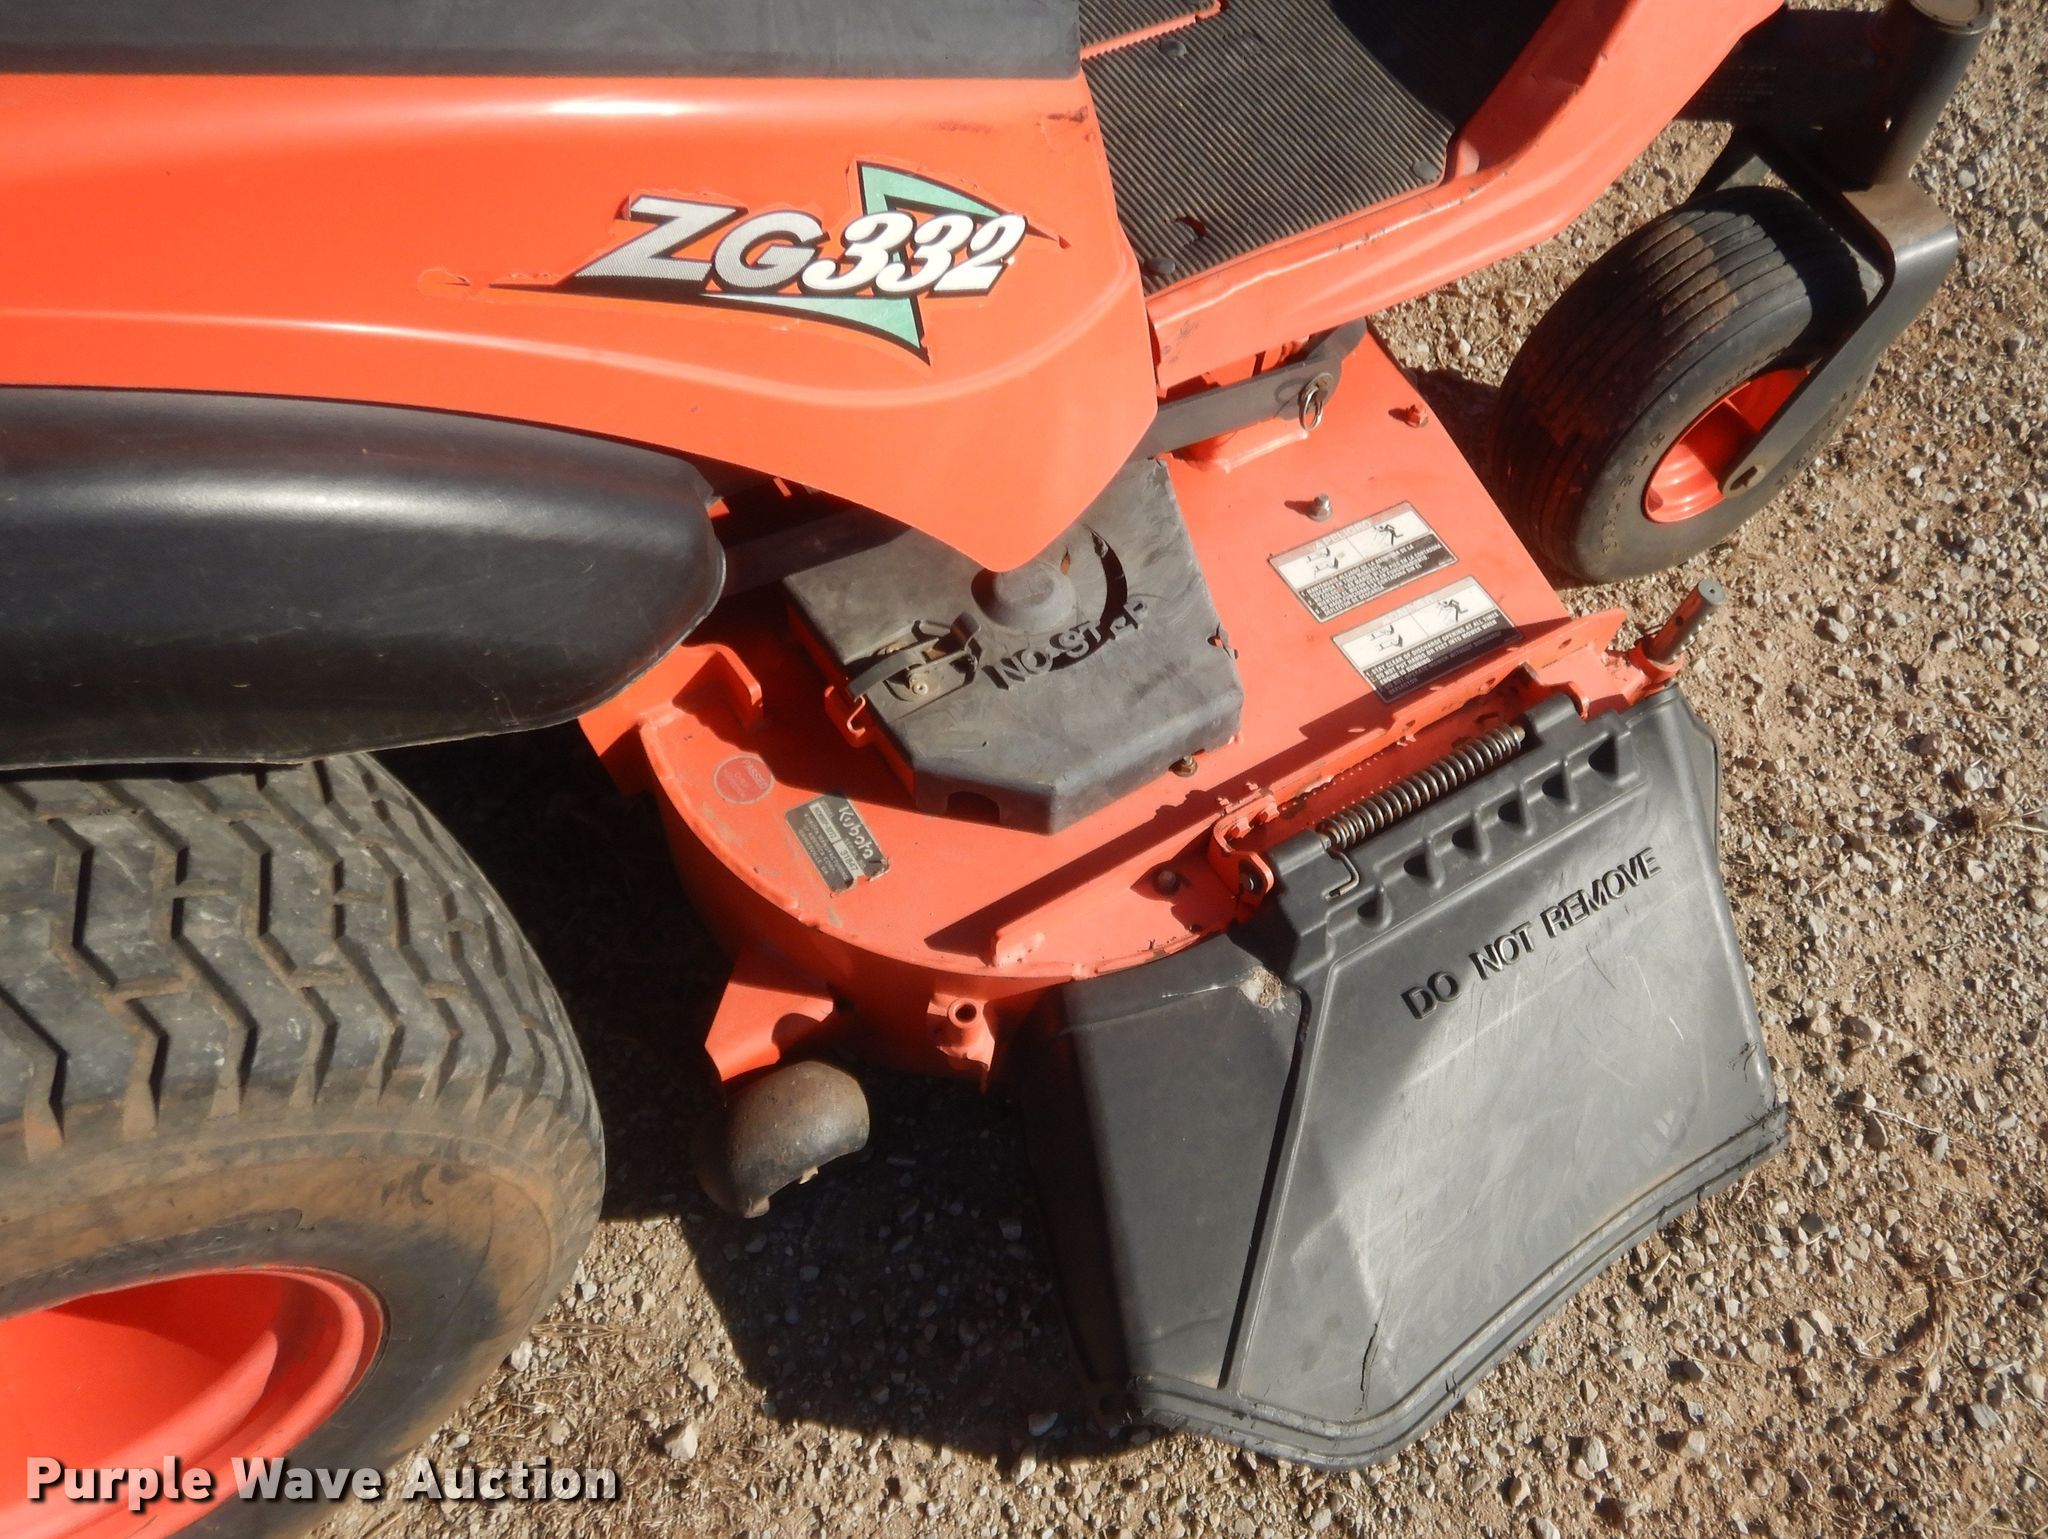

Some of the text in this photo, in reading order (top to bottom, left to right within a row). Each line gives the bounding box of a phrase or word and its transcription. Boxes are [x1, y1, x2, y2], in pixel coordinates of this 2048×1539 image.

[573, 196, 1027, 297] ZG332
[1322, 519, 1373, 545] PELIGRO
[982, 601, 1149, 691] NO STEP
[1370, 663, 1387, 674] STAY
[1384, 655, 1405, 668] CLEAR
[1402, 651, 1412, 659] OF
[1410, 637, 1442, 655] DISCHARGE
[1440, 626, 1466, 641] OPENING
[1471, 618, 1484, 626] ALL
[1374, 671, 1385, 680] DO
[1383, 666, 1397, 675] NOT
[1394, 660, 1408, 670] PUT
[1406, 651, 1427, 664] HANDS
[1425, 647, 1436, 655] OR
[1433, 641, 1449, 651] FEET
[1447, 635, 1462, 645] INTO
[1460, 625, 1482, 639] MOWER
[1378, 671, 1401, 685] ENGINE
[838, 806, 874, 859] Kubota
[1400, 847, 1663, 1020] DO NOT REMOVE
